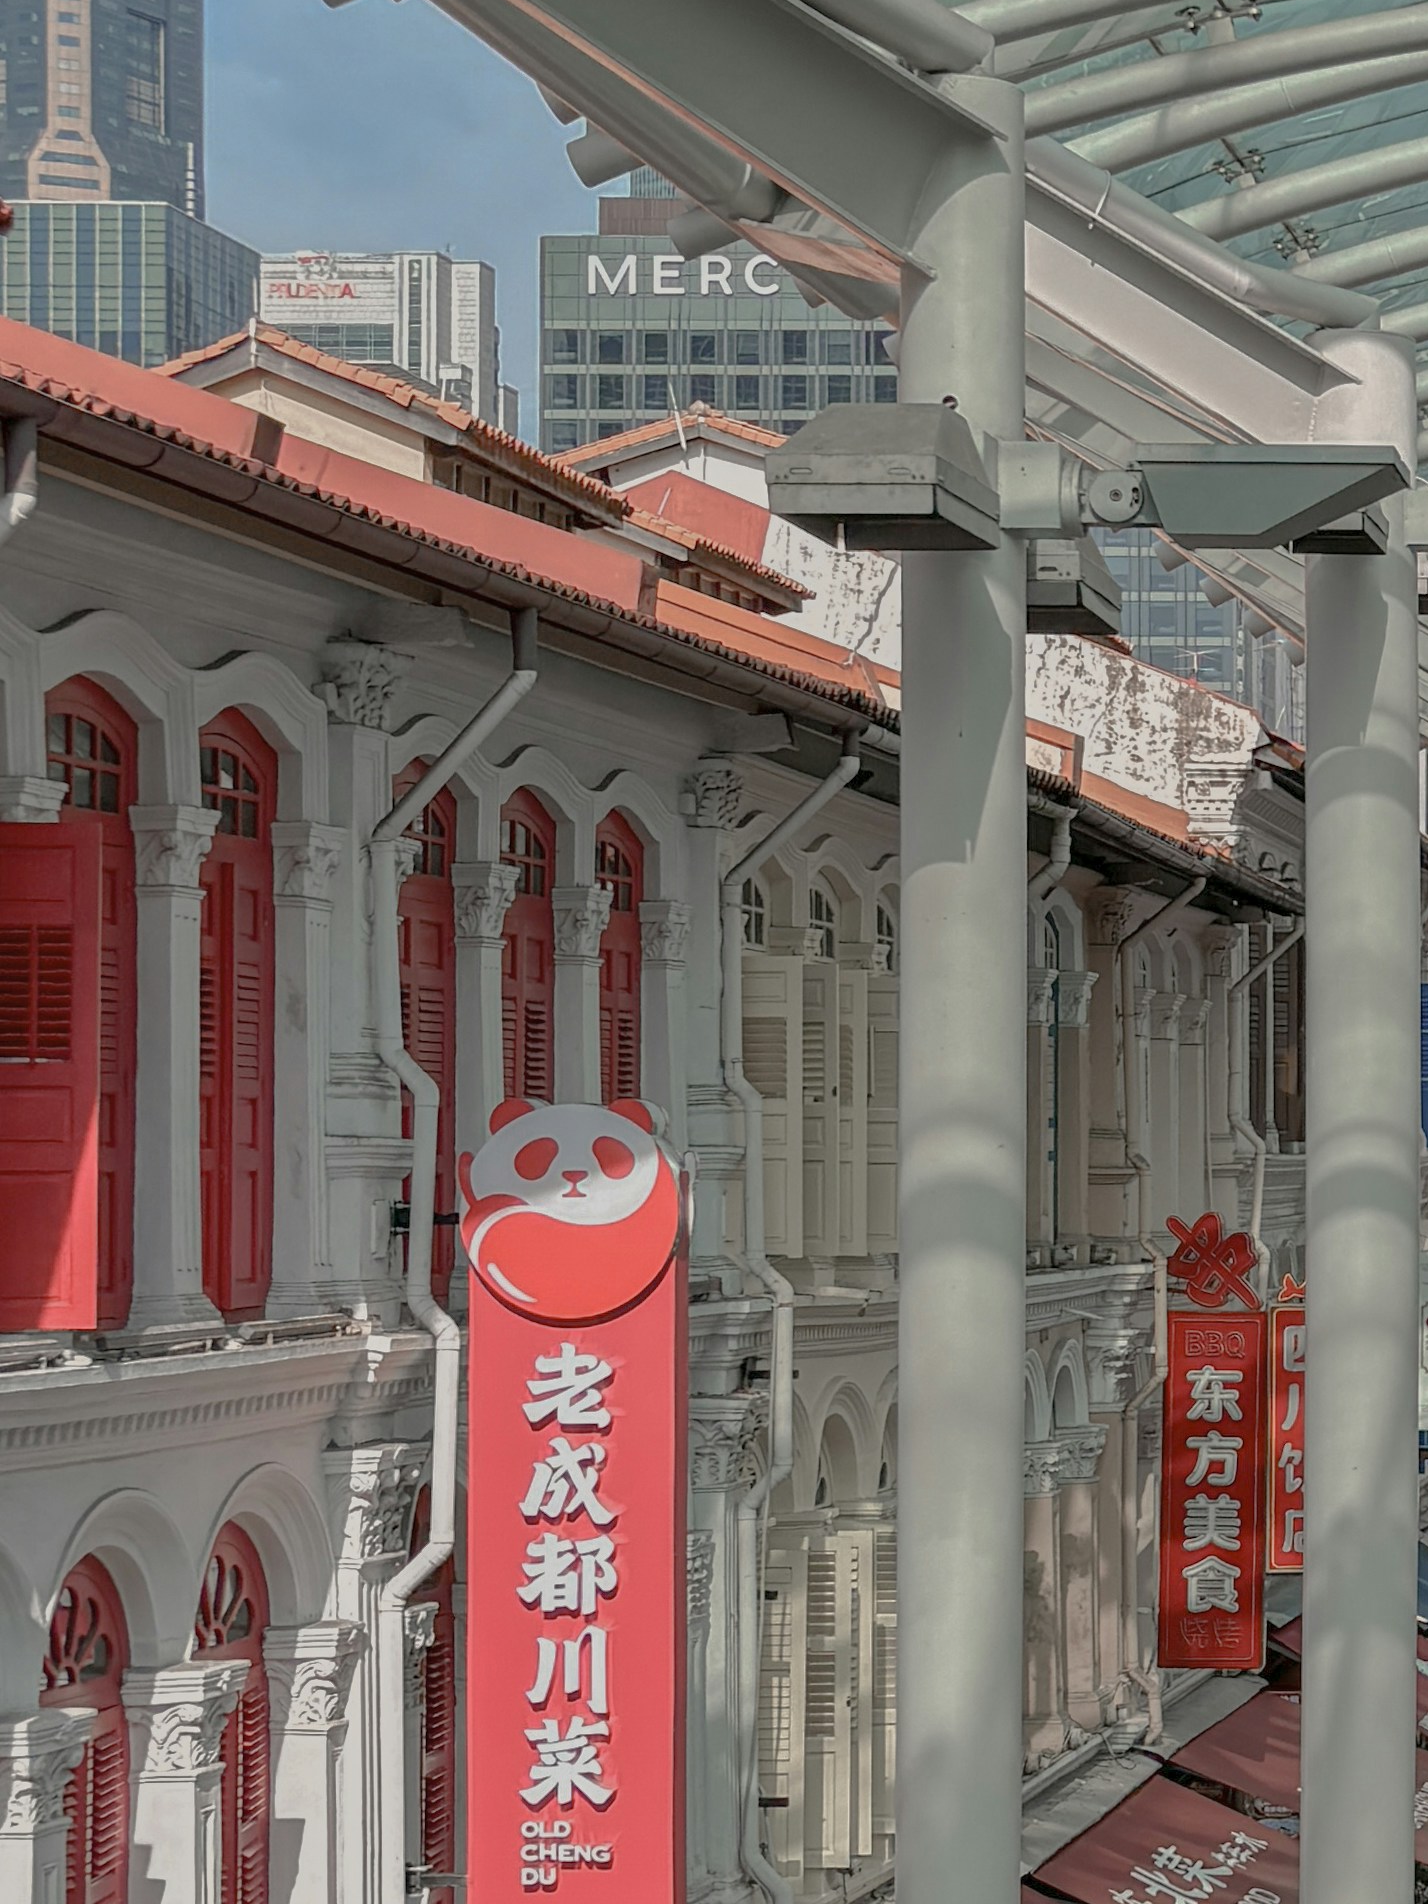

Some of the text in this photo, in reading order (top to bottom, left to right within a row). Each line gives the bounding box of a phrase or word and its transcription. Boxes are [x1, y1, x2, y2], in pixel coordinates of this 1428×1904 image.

[587, 254, 780, 296] MERC
[1184, 1328, 1246, 1359] BBQ
[1182, 1365, 1244, 1615] 东方美食
[516, 1342, 617, 1805] 老成都川菜
[520, 1820, 572, 1839] OLD
[520, 1844, 611, 1864] CHENG
[520, 1867, 557, 1887] DU
